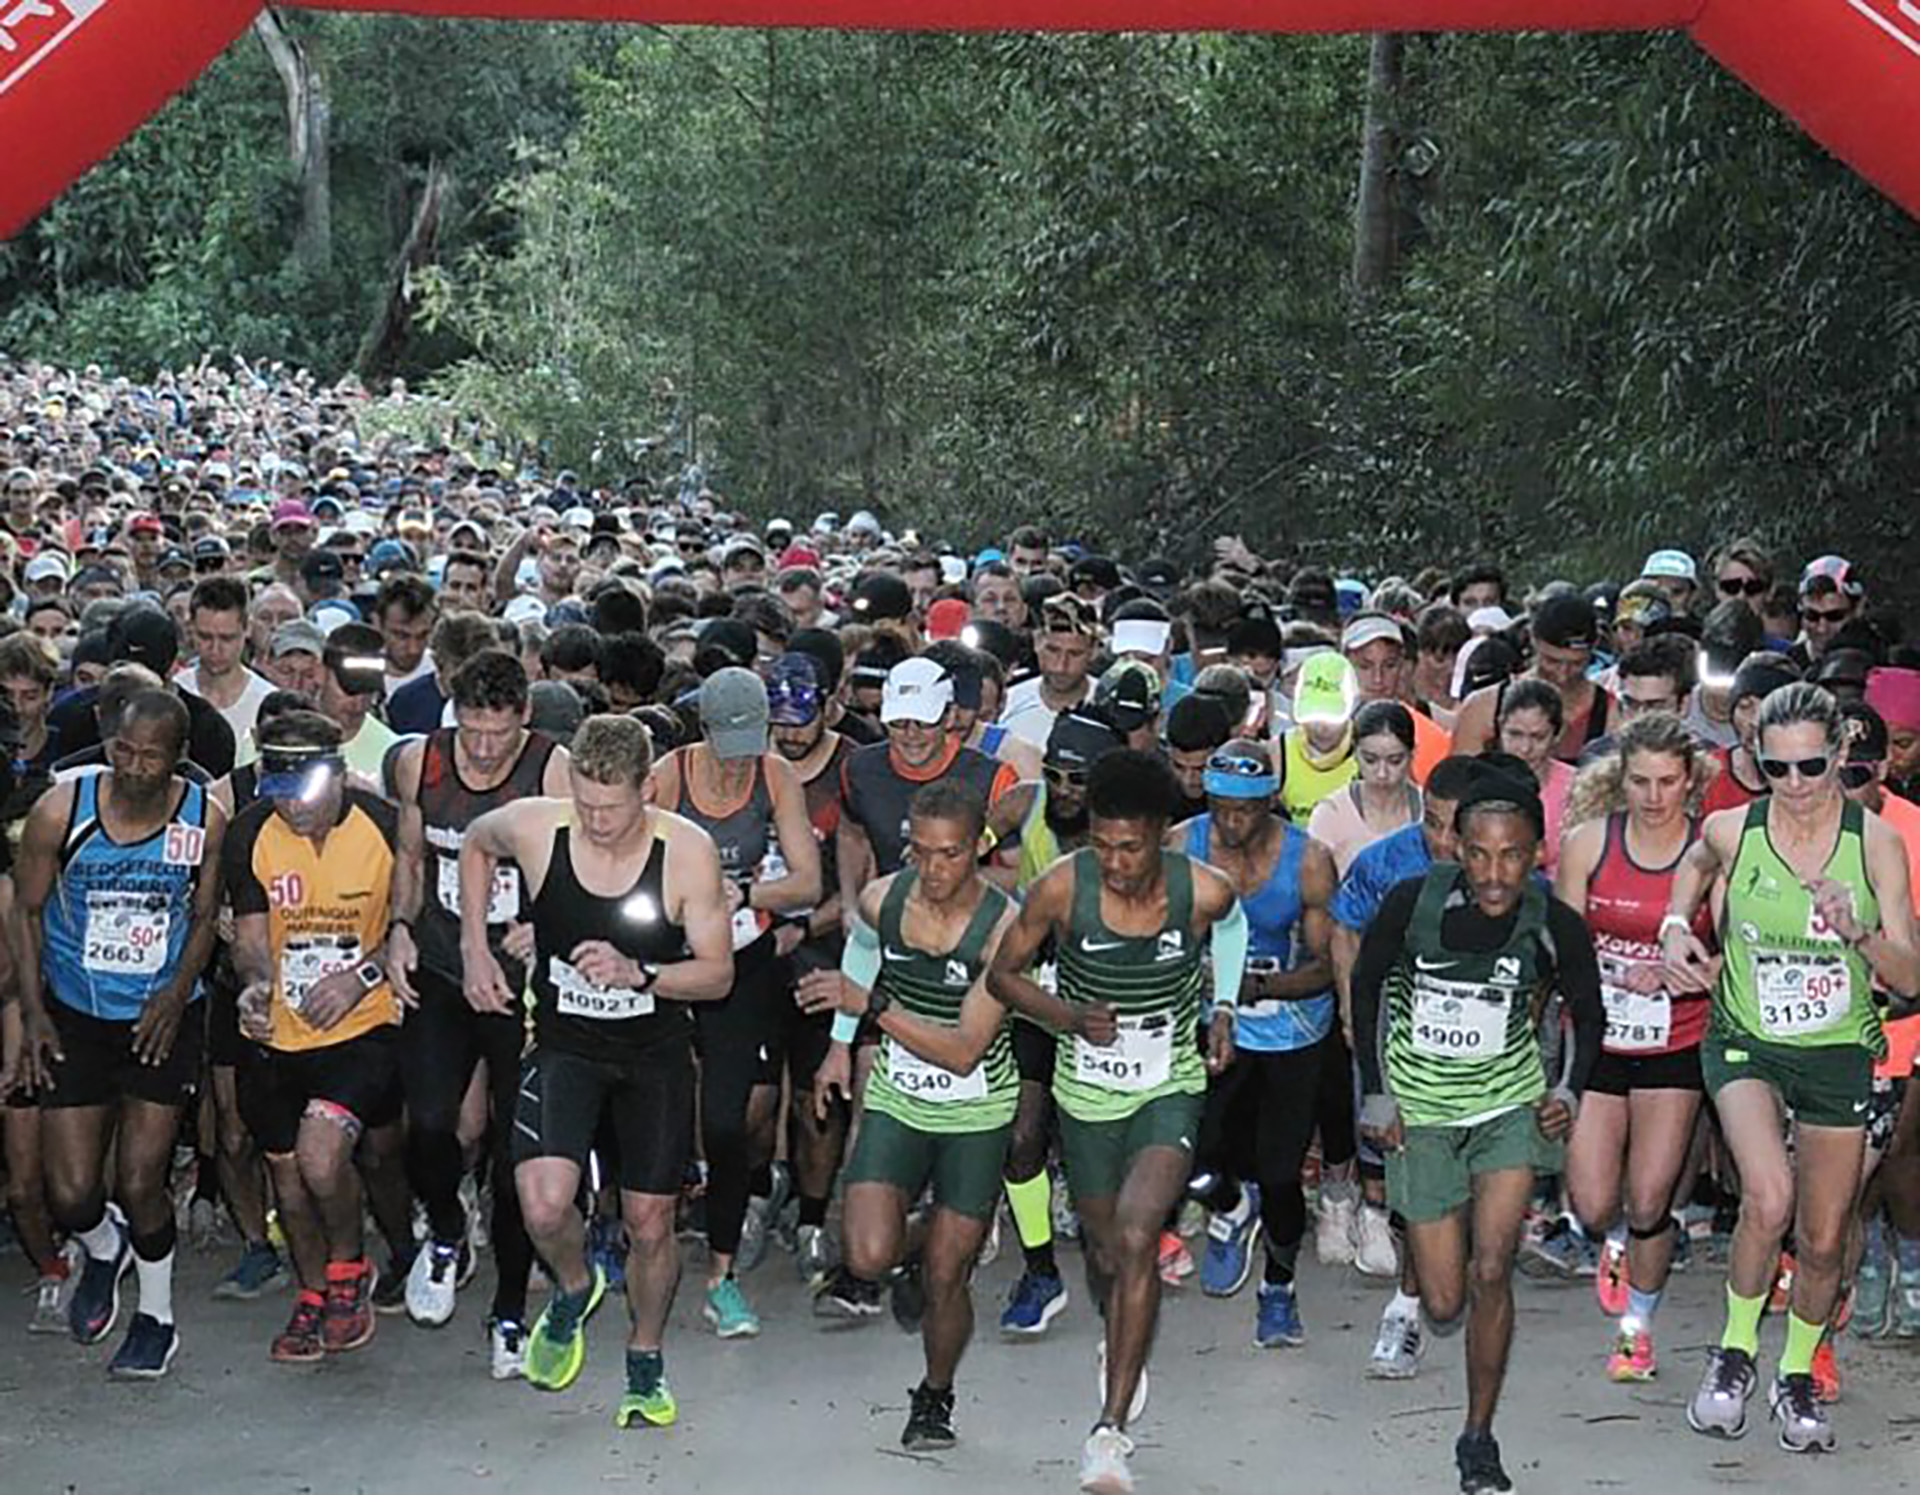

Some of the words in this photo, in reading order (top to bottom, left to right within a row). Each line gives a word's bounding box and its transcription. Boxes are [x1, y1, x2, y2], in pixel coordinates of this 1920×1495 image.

[167, 826, 201, 861] 50
[270, 873, 302, 905] 50
[88, 941, 145, 964] 2663
[1806, 975, 1845, 1000] 50+
[1763, 1000, 1828, 1024] 3133
[1417, 1024, 1481, 1047] 4900
[1083, 1054, 1143, 1079] 5401
[893, 1071, 952, 1092] 5340
